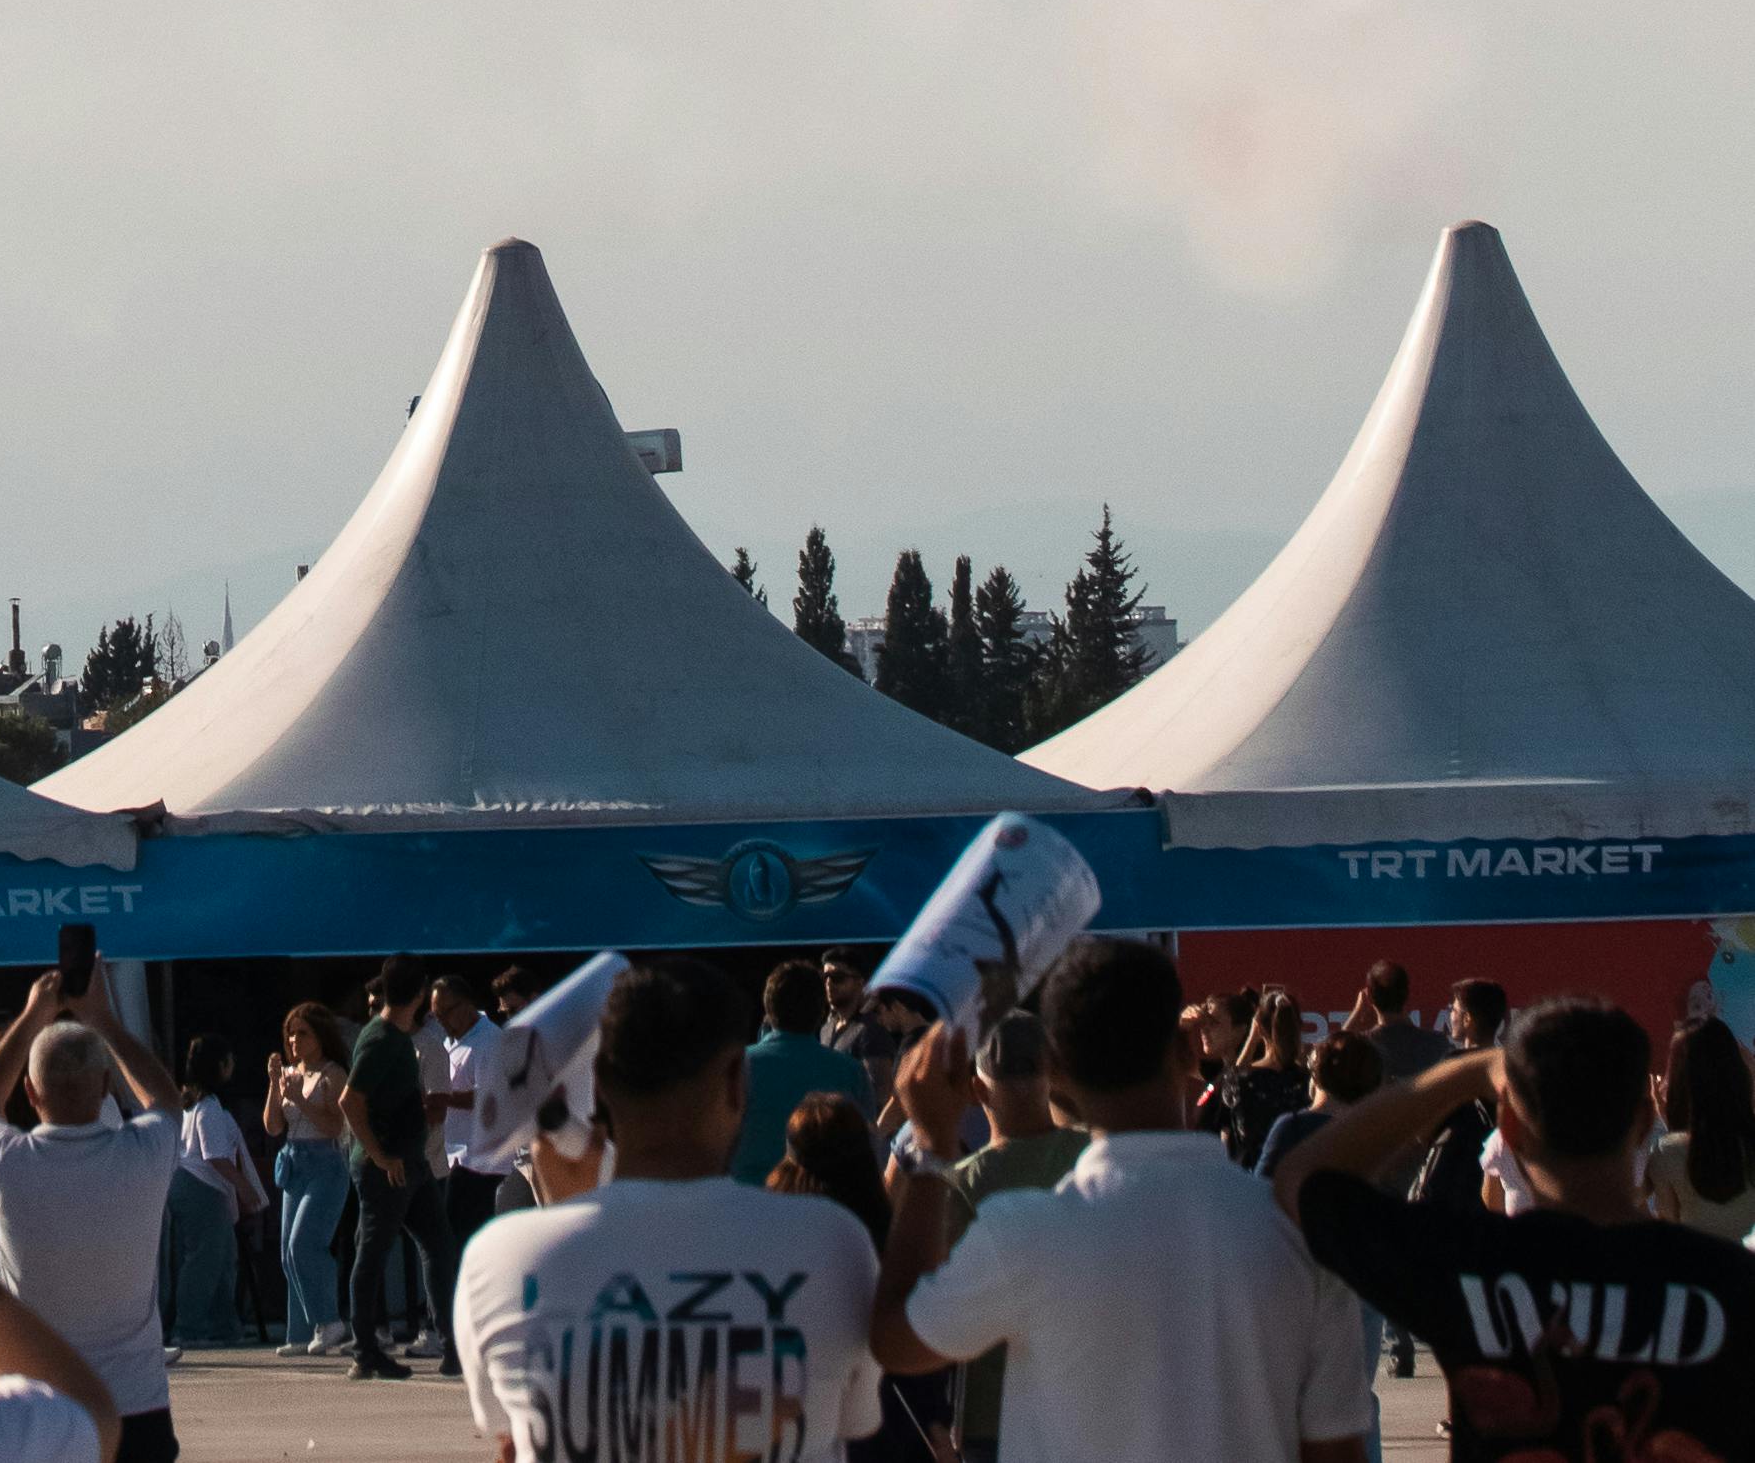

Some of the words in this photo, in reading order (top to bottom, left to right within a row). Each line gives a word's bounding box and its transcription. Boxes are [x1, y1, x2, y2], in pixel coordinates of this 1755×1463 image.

[1338, 850, 1437, 879] TRT
[1447, 844, 1663, 877] MARKET
[1458, 1272, 1727, 1366] WILD
